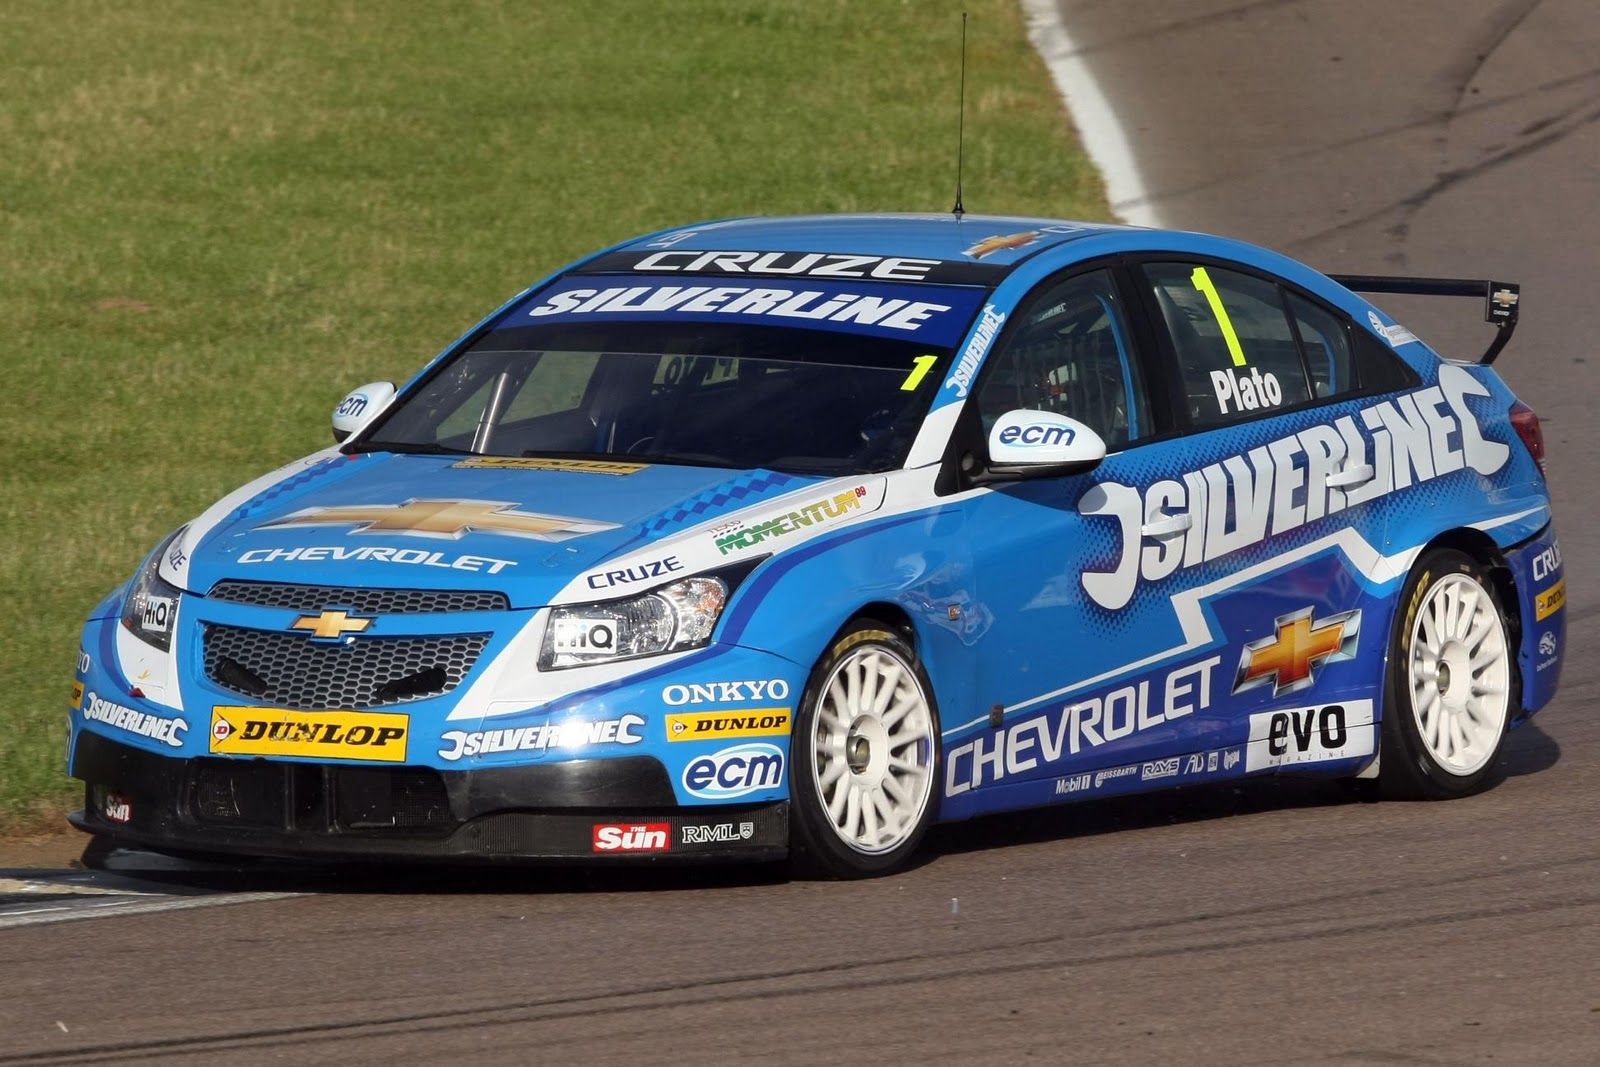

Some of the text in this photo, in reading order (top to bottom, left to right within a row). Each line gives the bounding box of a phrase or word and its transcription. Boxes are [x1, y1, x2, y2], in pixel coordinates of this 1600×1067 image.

[632, 250, 941, 280] CRUZE
[1190, 266, 1246, 367] 1
[900, 354, 938, 391] 1
[1209, 366, 1282, 414] Plato
[999, 425, 1076, 446] ecm
[715, 489, 861, 556] MOMENTUM
[236, 546, 519, 575] CHEVROLET
[586, 555, 686, 590] CRUZE
[1532, 540, 1562, 581] CRU
[143, 600, 167, 627] HiQ
[662, 679, 790, 707] ONKYO
[238, 719, 406, 746] DUNLOP
[693, 715, 787, 733] DUNLOP
[945, 655, 1221, 798] CHEVROLET
[685, 754, 783, 792] ecm
[1144, 758, 1179, 777] RAYS
[1055, 774, 1081, 795] Mobil
[594, 826, 667, 850] Sun
[682, 824, 741, 844] RML
